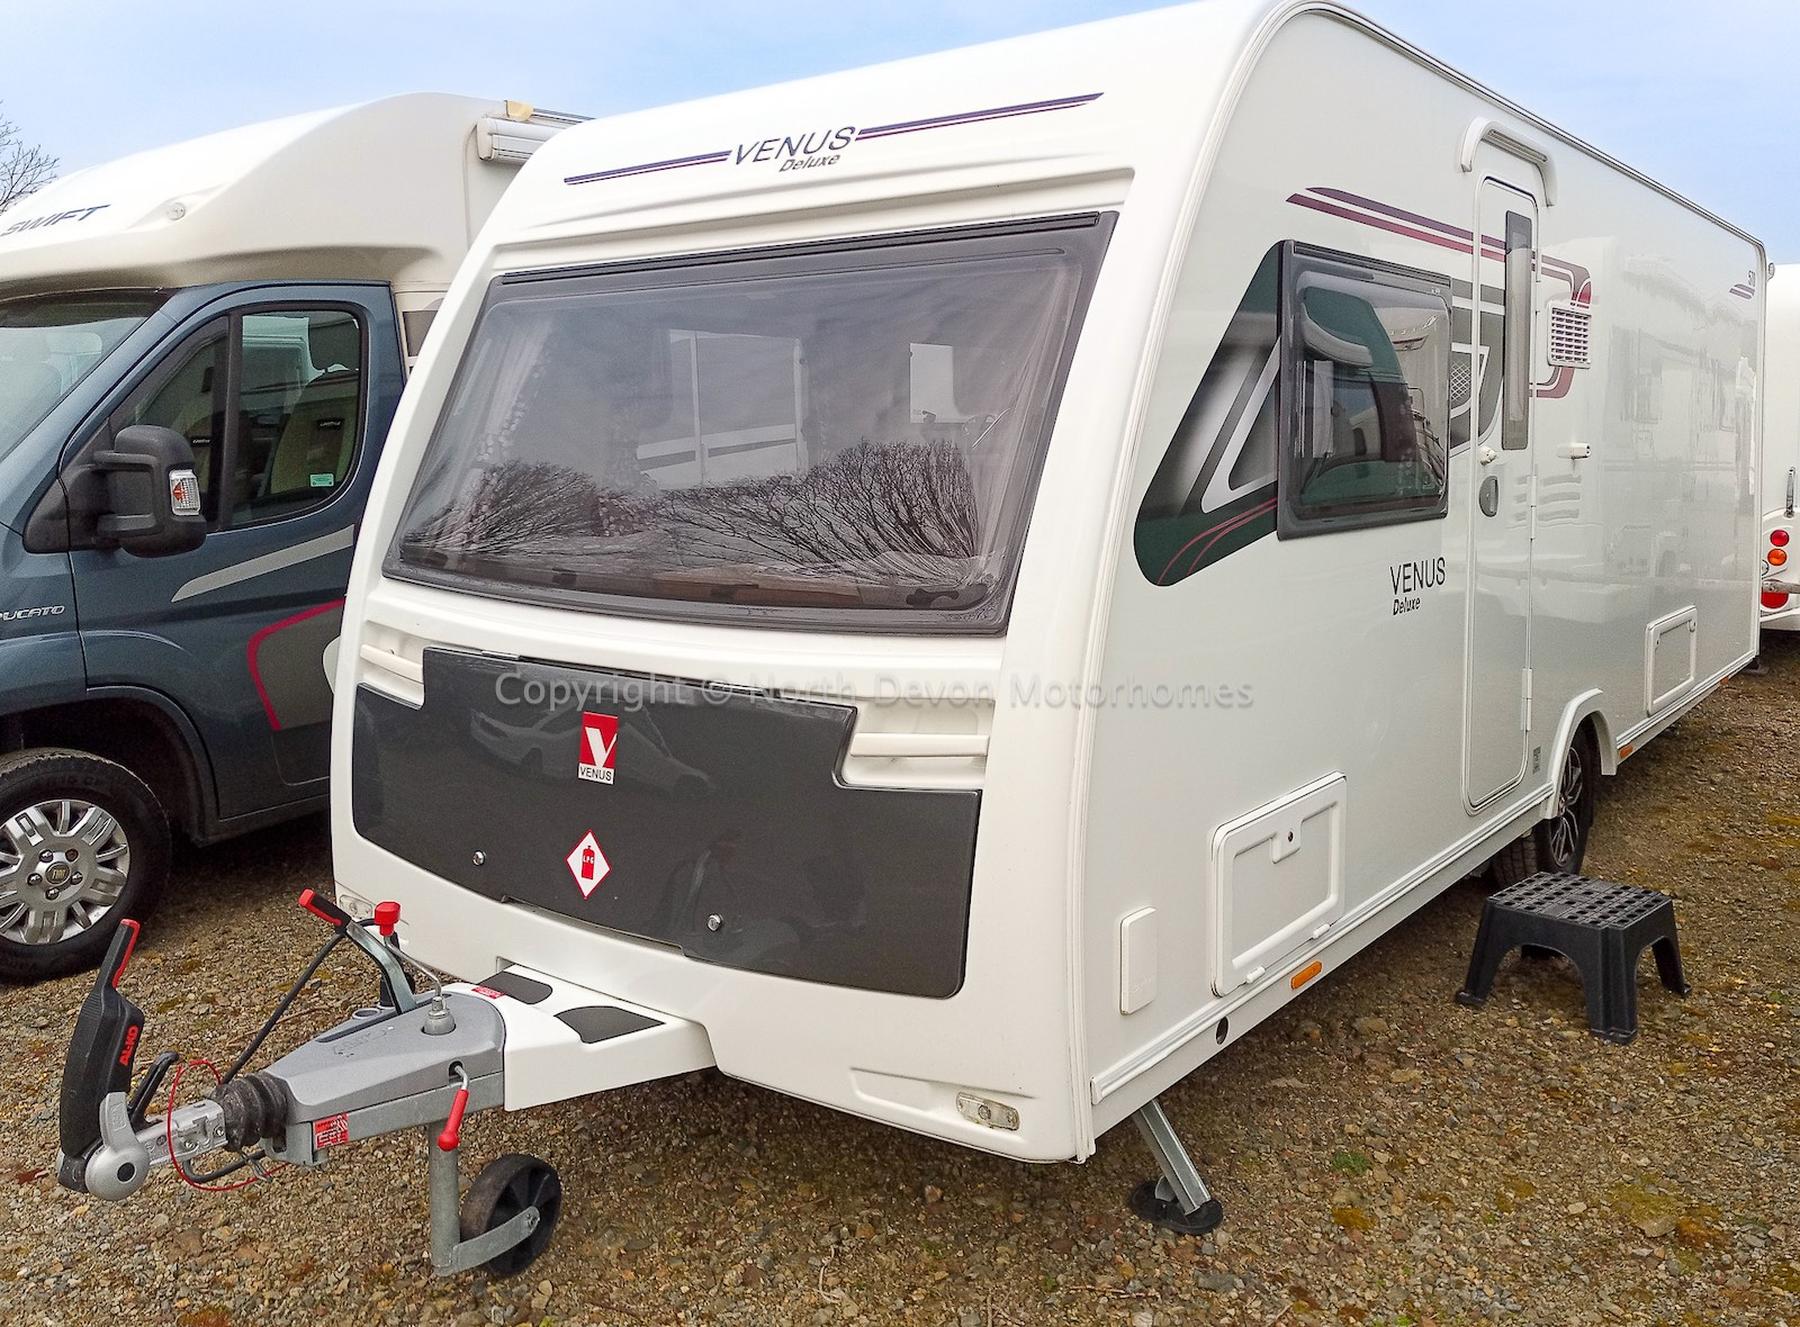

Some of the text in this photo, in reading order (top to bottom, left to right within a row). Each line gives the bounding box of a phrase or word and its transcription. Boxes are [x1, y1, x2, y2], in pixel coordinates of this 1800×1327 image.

[735, 126, 856, 166] VENUS
[778, 154, 841, 173] Deluxe
[0, 204, 111, 237] SWIFT
[1389, 556, 1446, 595] VENUS
[1392, 597, 1421, 616] Deluxe
[579, 766, 613, 782] VENUS
